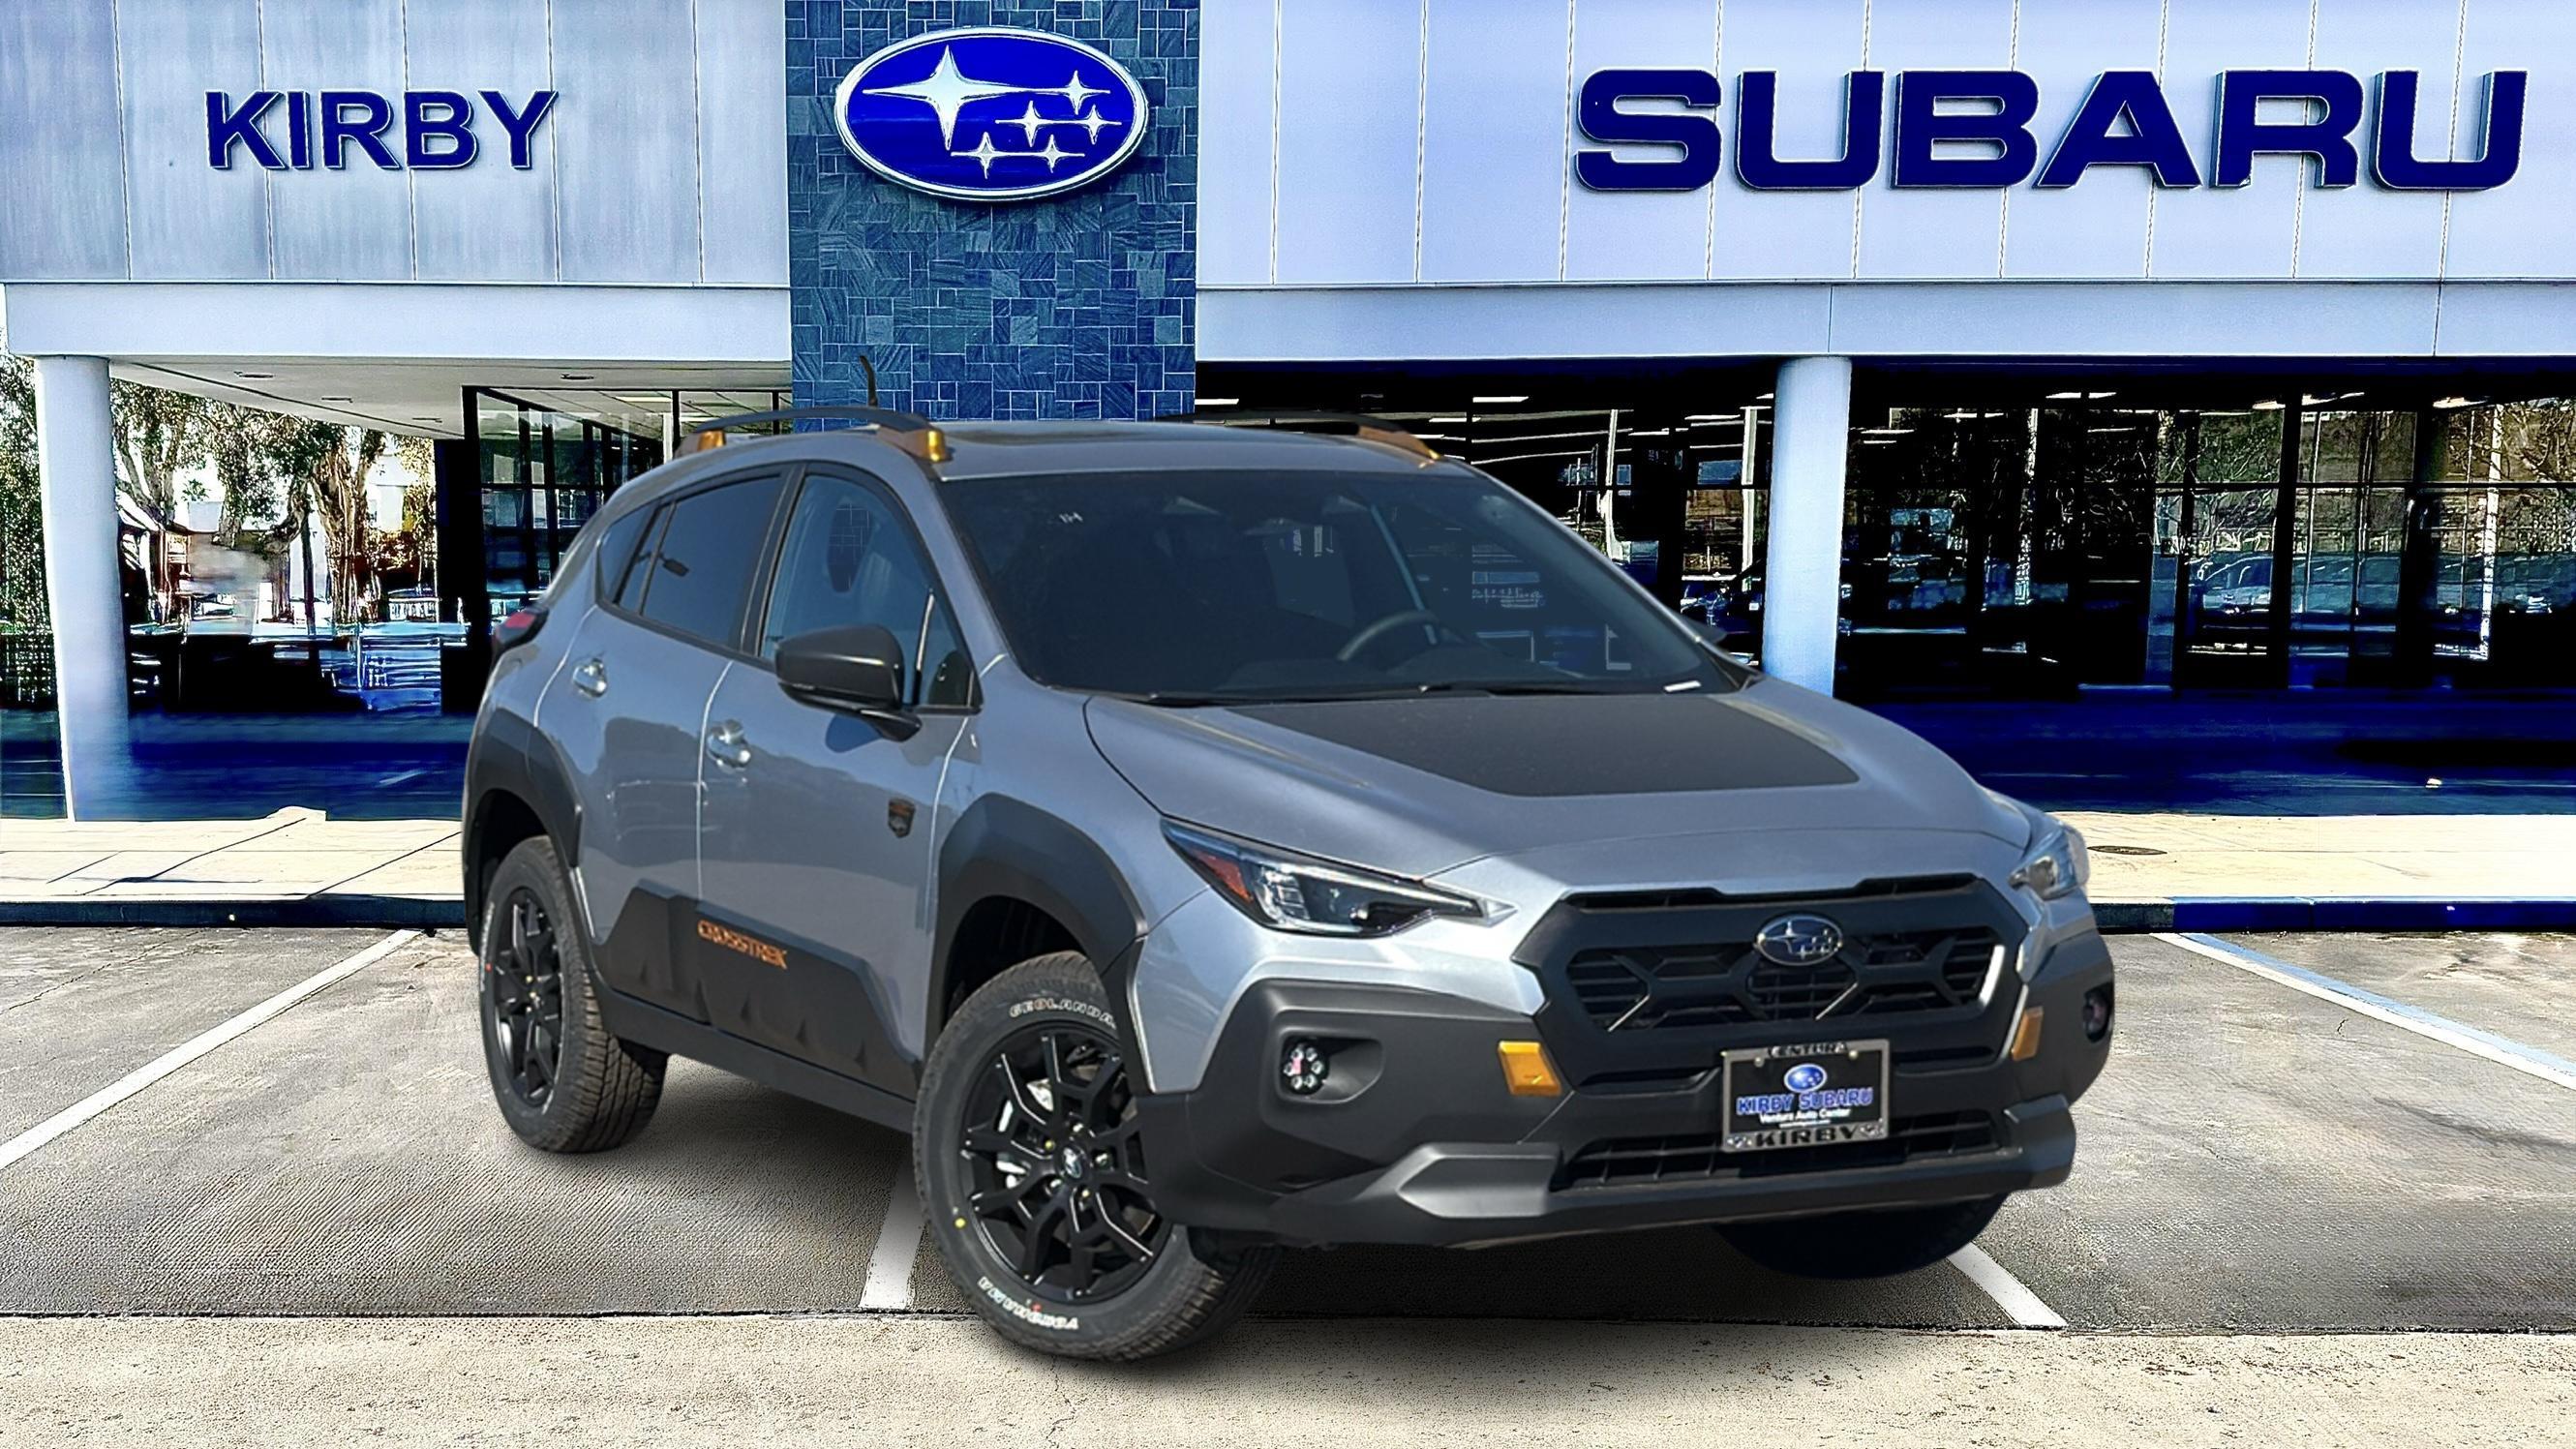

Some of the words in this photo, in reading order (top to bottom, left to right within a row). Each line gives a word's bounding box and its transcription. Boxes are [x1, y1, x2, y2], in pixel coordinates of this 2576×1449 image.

[204, 89, 559, 170] KIRBY
[1575, 69, 2528, 192] SUBARU
[697, 920, 788, 970] CROSSTREK
[1736, 1094, 1795, 1115] KIRBY
[1799, 1087, 1874, 1110] SUBARU
[1756, 1127, 1859, 1148] KIRBY
